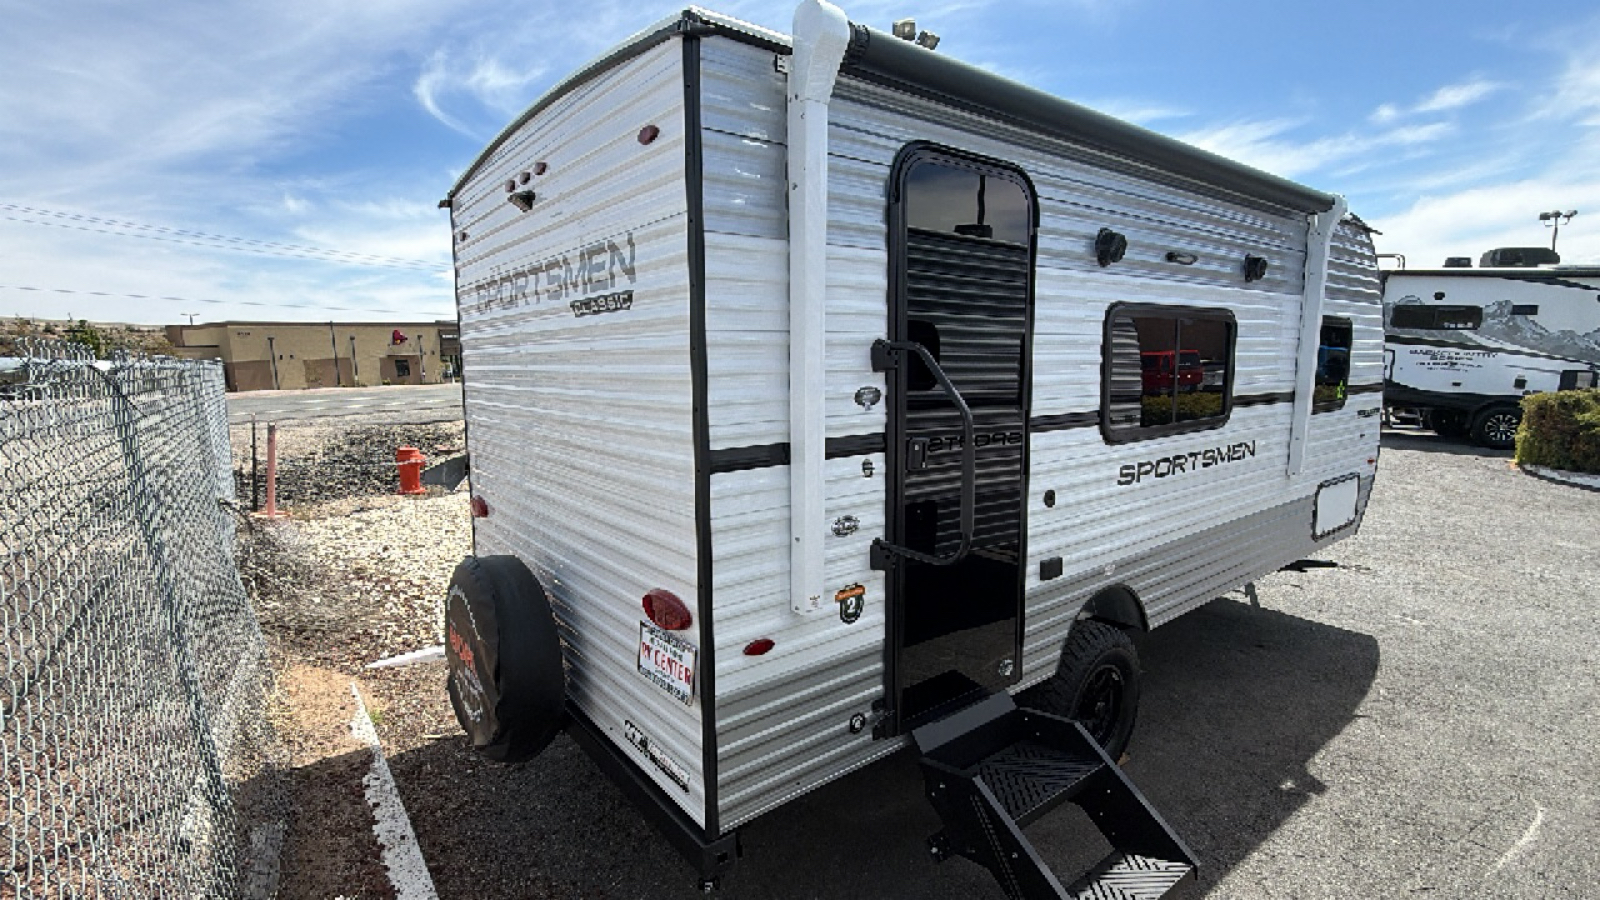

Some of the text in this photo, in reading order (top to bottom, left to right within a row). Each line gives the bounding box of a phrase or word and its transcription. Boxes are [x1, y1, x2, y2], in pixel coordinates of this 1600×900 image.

[475, 232, 636, 315] SPORTSMEN
[573, 293, 632, 317] CLASSIC
[1117, 440, 1255, 485] SPORTSMEN
[654, 649, 691, 686] CENTER
